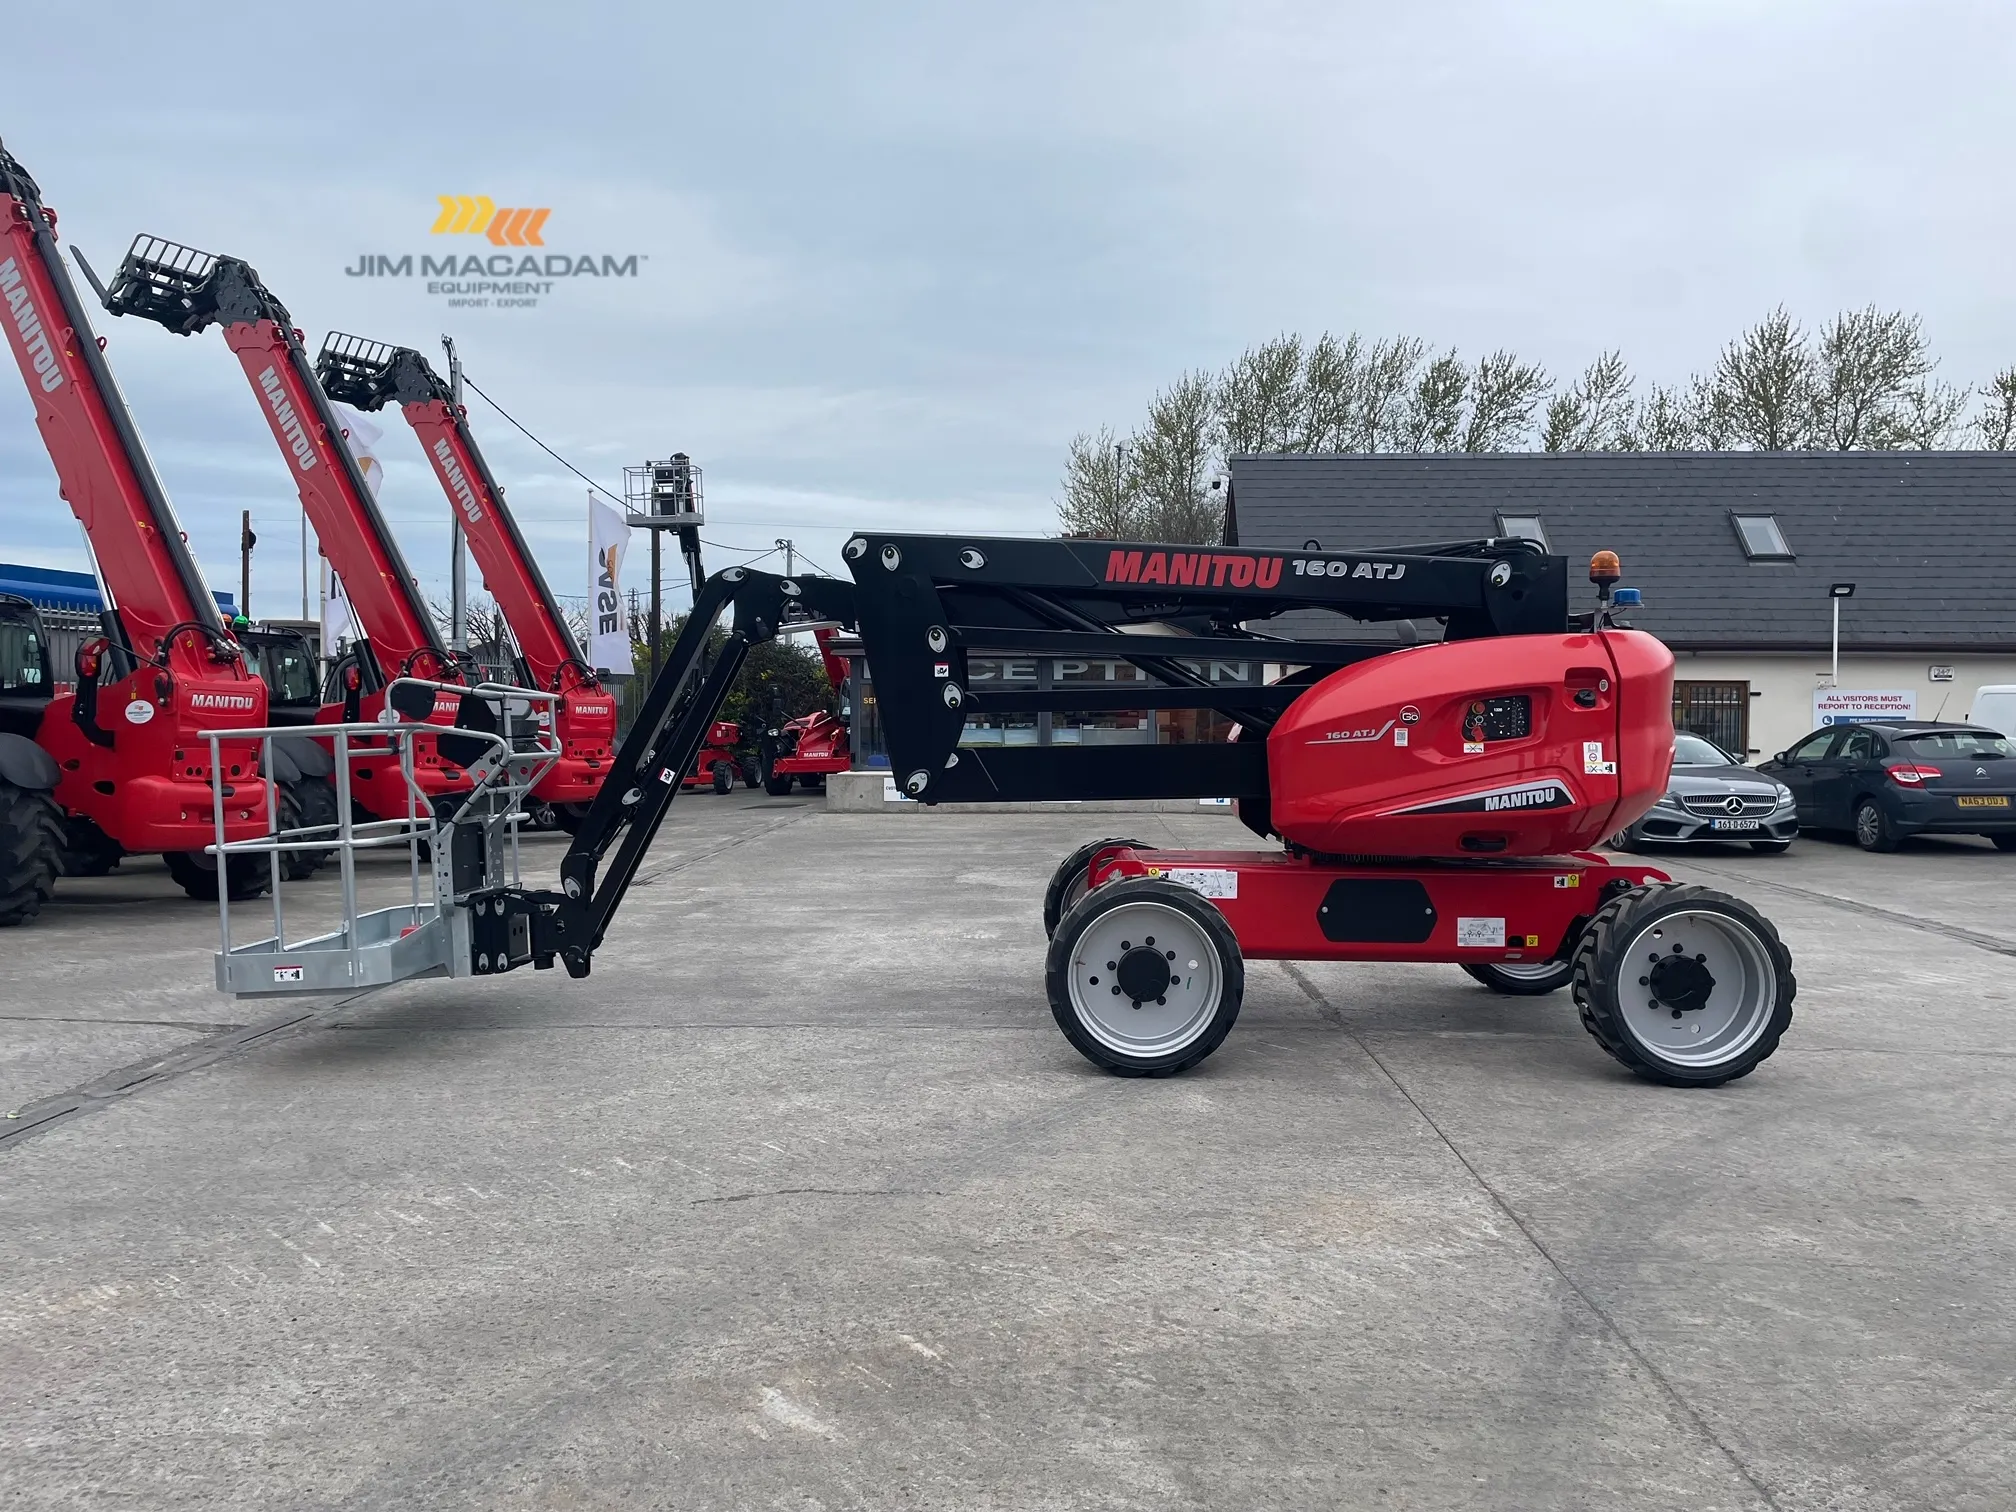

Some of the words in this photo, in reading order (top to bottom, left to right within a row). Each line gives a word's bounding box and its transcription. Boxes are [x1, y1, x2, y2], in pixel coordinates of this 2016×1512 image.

[0, 256, 64, 393] MANITOU
[258, 366, 318, 471] MANITOU
[433, 437, 483, 523] MANITOU
[1105, 550, 1283, 589] MANITOU
[1292, 559, 1347, 577] 160
[1352, 562, 1406, 580] ATJ
[192, 694, 253, 709] MANITOU
[575, 706, 608, 714] MANITOU
[1326, 731, 1350, 739] 160
[1352, 729, 1375, 738] ATJ
[1485, 788, 1556, 811] MANITOU
[1961, 797, 1985, 805] NA63
